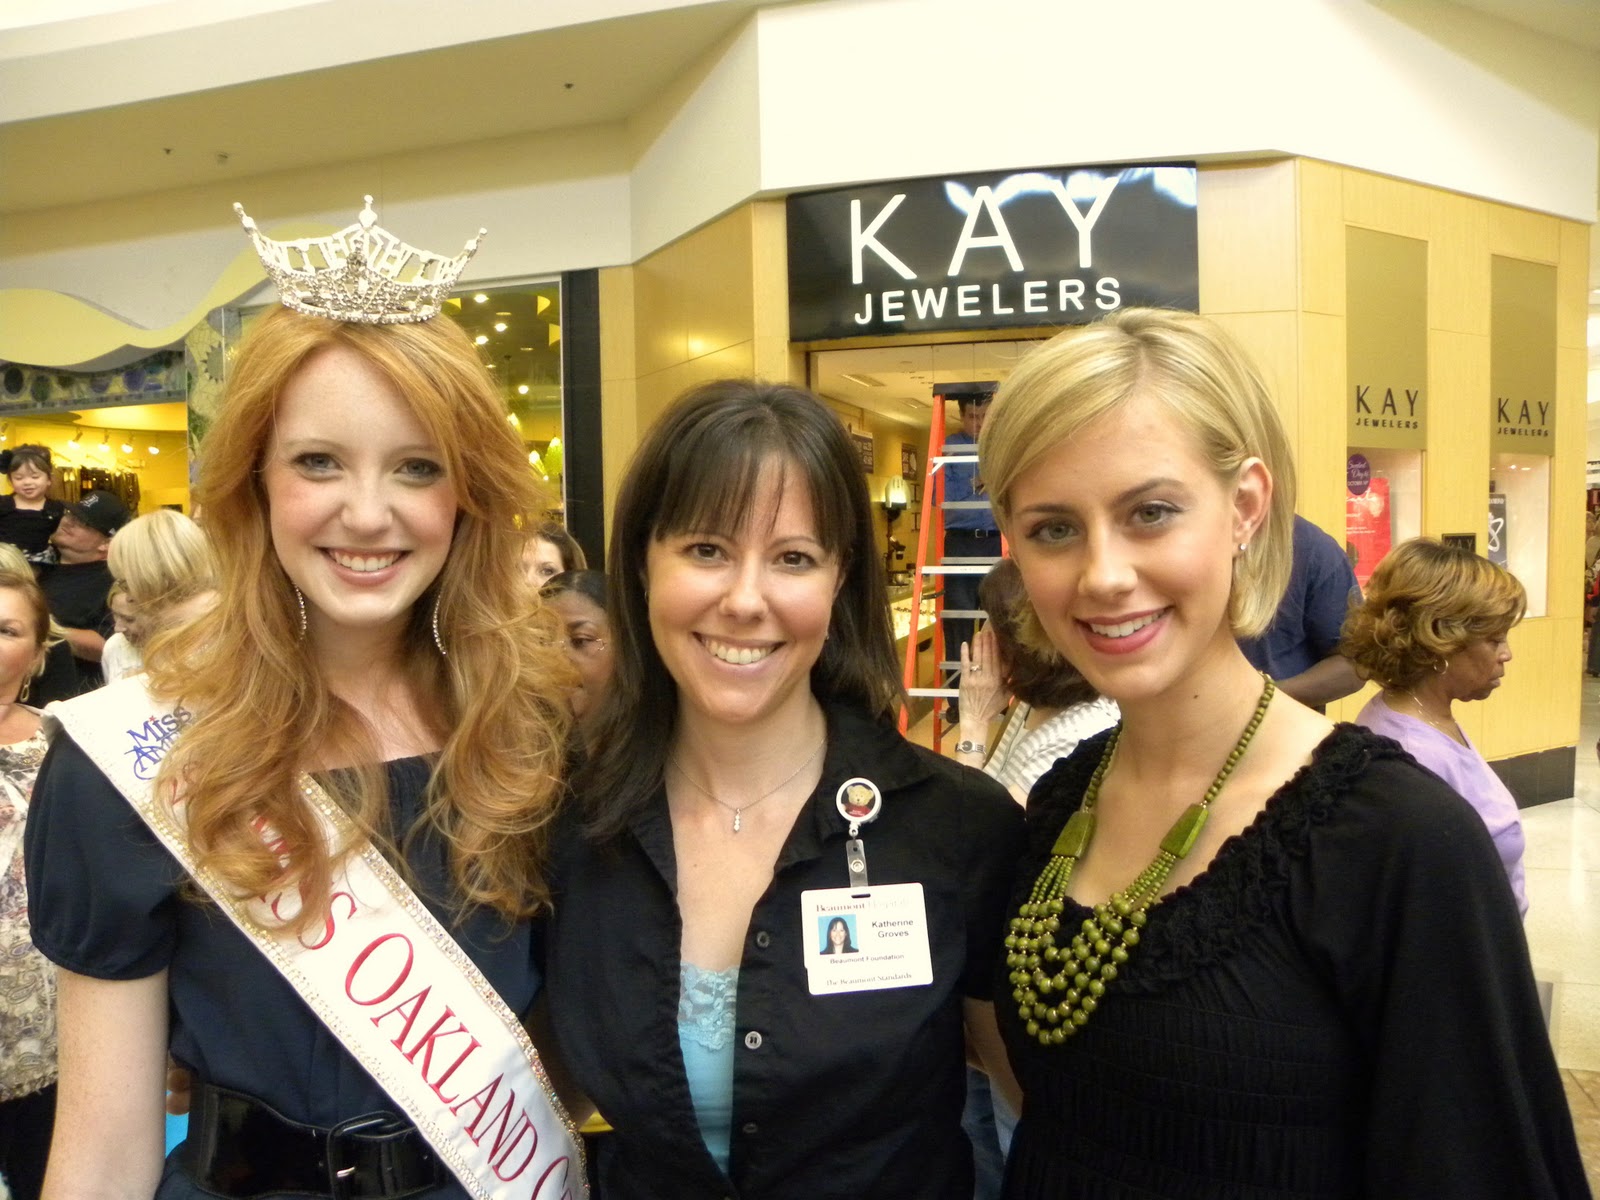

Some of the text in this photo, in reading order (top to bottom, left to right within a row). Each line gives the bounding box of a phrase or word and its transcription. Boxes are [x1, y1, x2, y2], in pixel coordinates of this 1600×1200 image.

[850, 177, 1119, 284] KAY
[854, 277, 1121, 325] JEWELERS
[1356, 385, 1419, 416] KAY
[1497, 398, 1549, 425] KAY
[1356, 418, 1418, 429] JEWELERS
[1497, 427, 1549, 437] JEWELERS
[871, 919, 914, 928] Katherine
[877, 930, 910, 938] Groves
[830, 953, 905, 964] Beaumont Foundation
[345, 933, 539, 1181] OAKLAND
